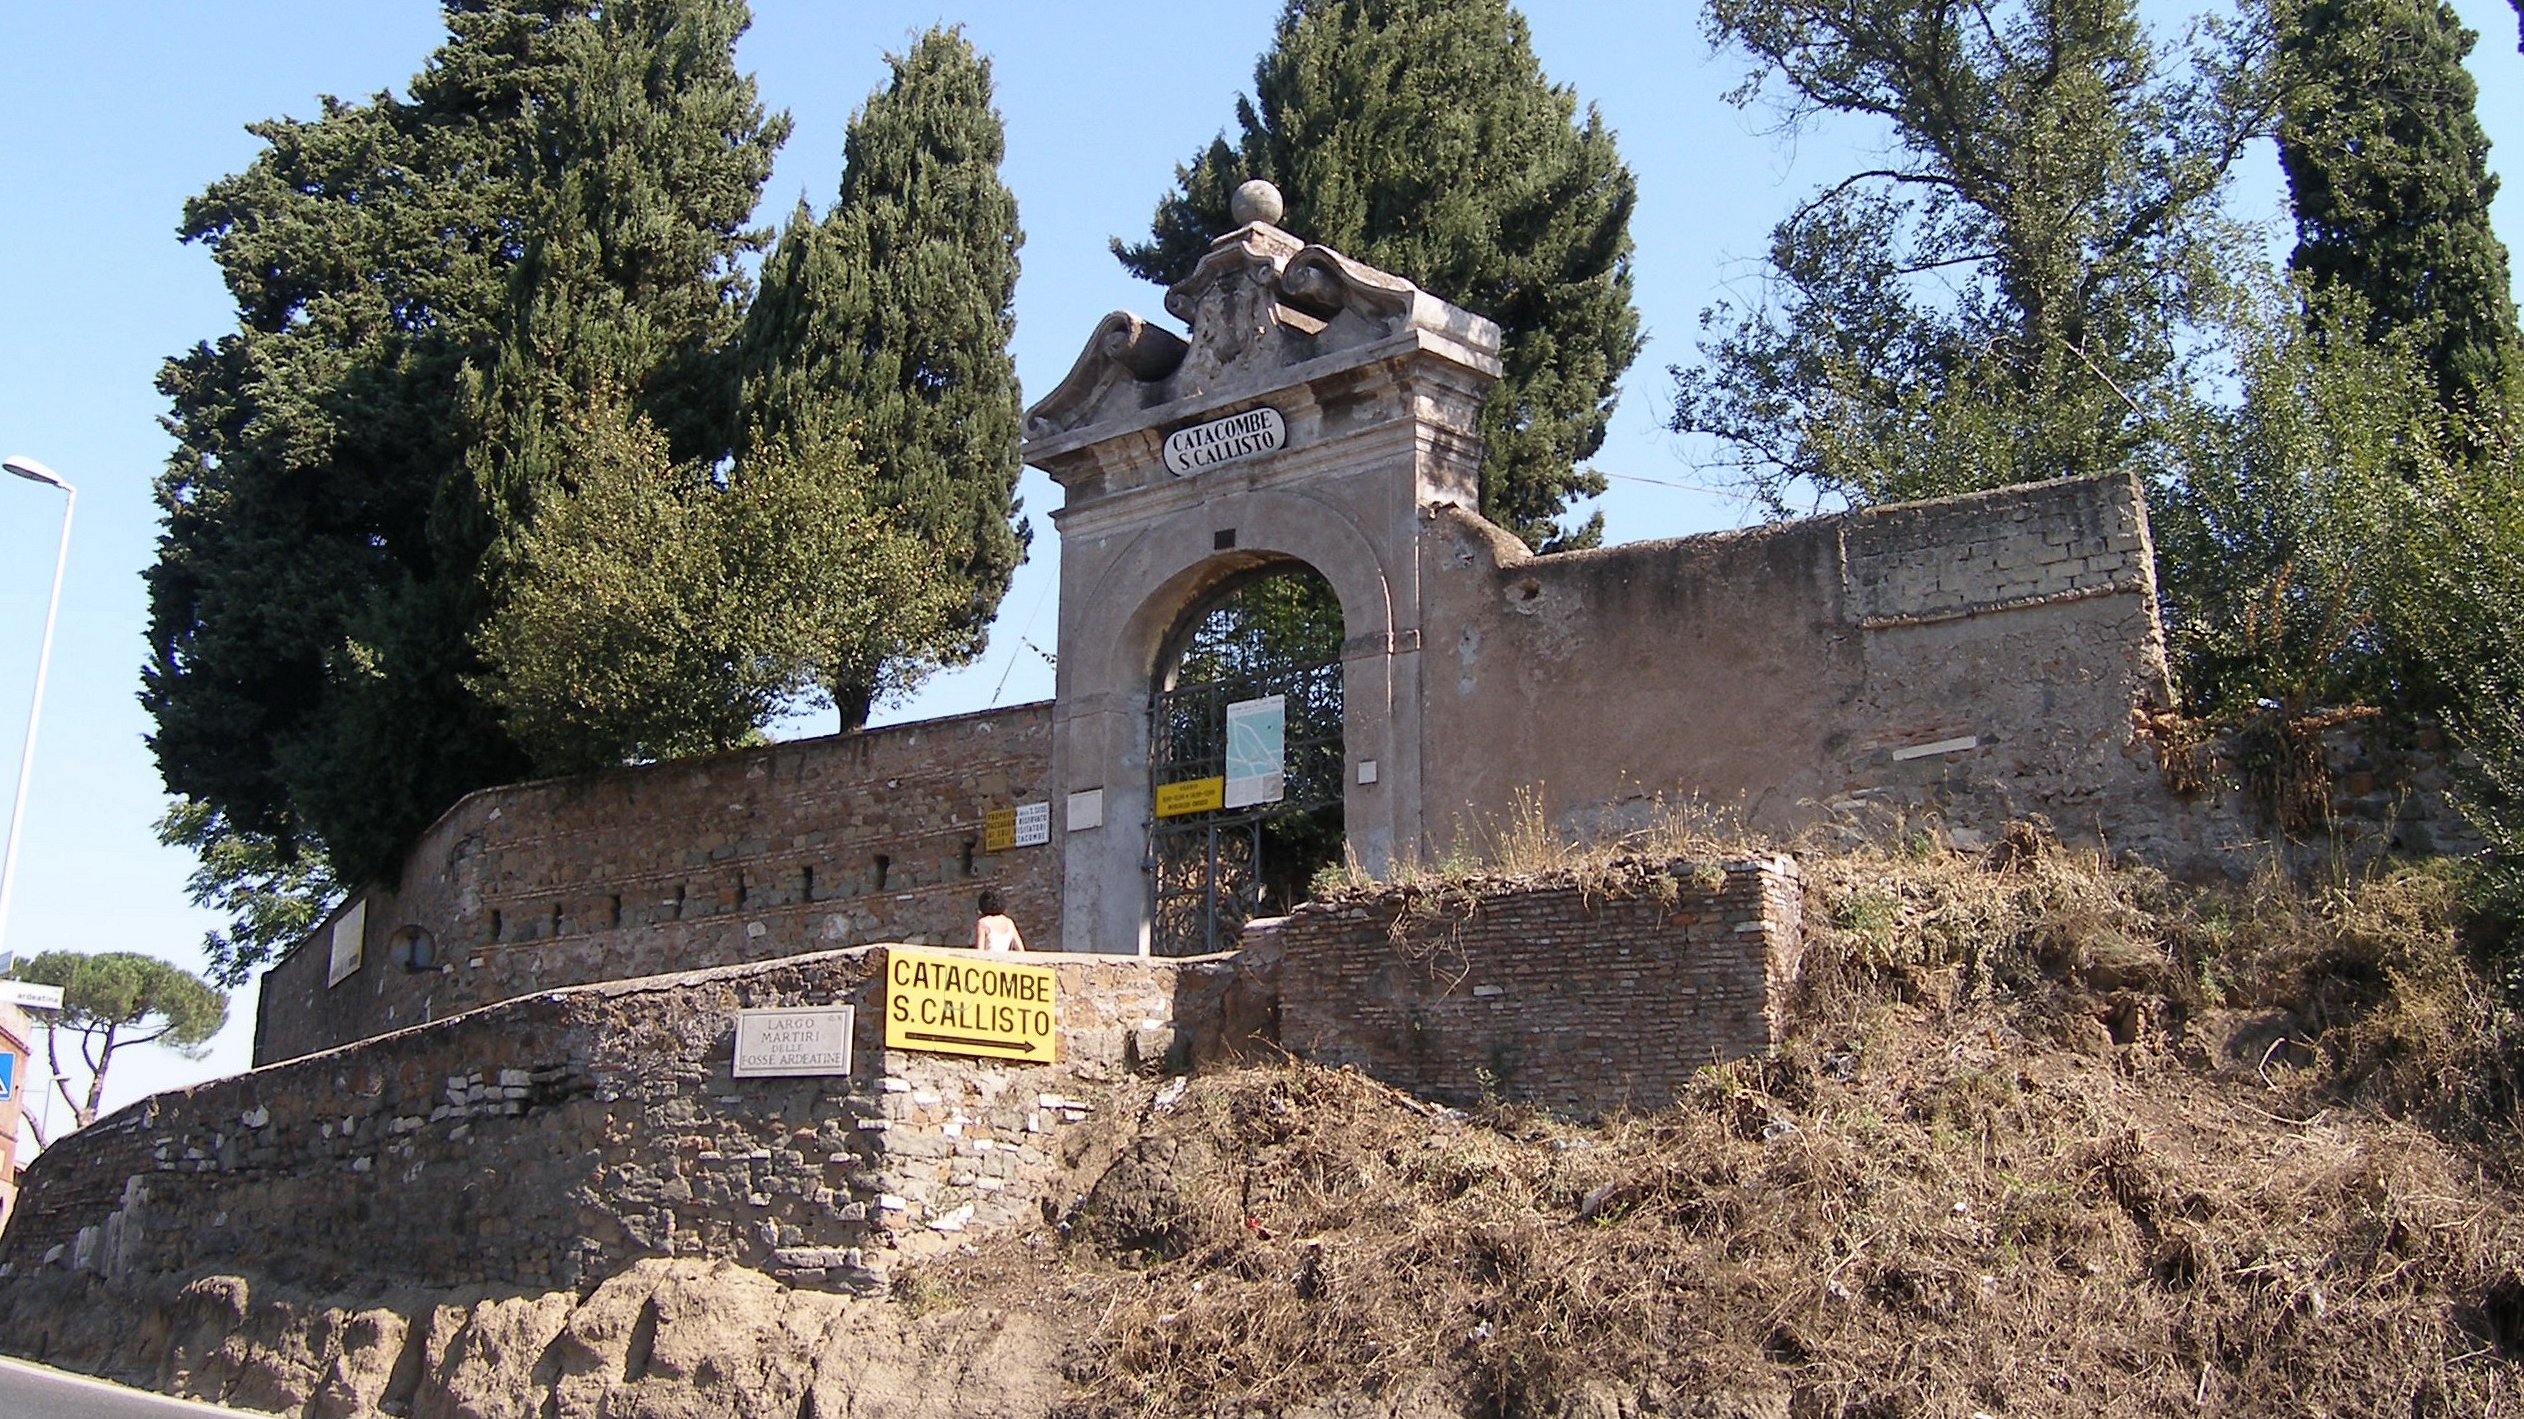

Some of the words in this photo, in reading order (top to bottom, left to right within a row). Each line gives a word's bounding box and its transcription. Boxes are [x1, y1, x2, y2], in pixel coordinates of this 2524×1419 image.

[1173, 410, 1272, 451] CATACOMBE
[1194, 431, 1274, 466] CALLISTO
[1014, 823, 1046, 834] ISITATORI
[1010, 832, 1045, 844] CTACOMBE
[894, 959, 1050, 1003] CATACOMBE
[17, 993, 59, 1002] ardeatina
[921, 998, 1050, 1036] CALLISTO
[768, 1018, 815, 1030] LARGO
[761, 1032, 820, 1043] MARTIRI
[771, 1044, 804, 1053] DELLE
[742, 1055, 776, 1065] FOSSE
[780, 1052, 841, 1065] ARDEATINE
